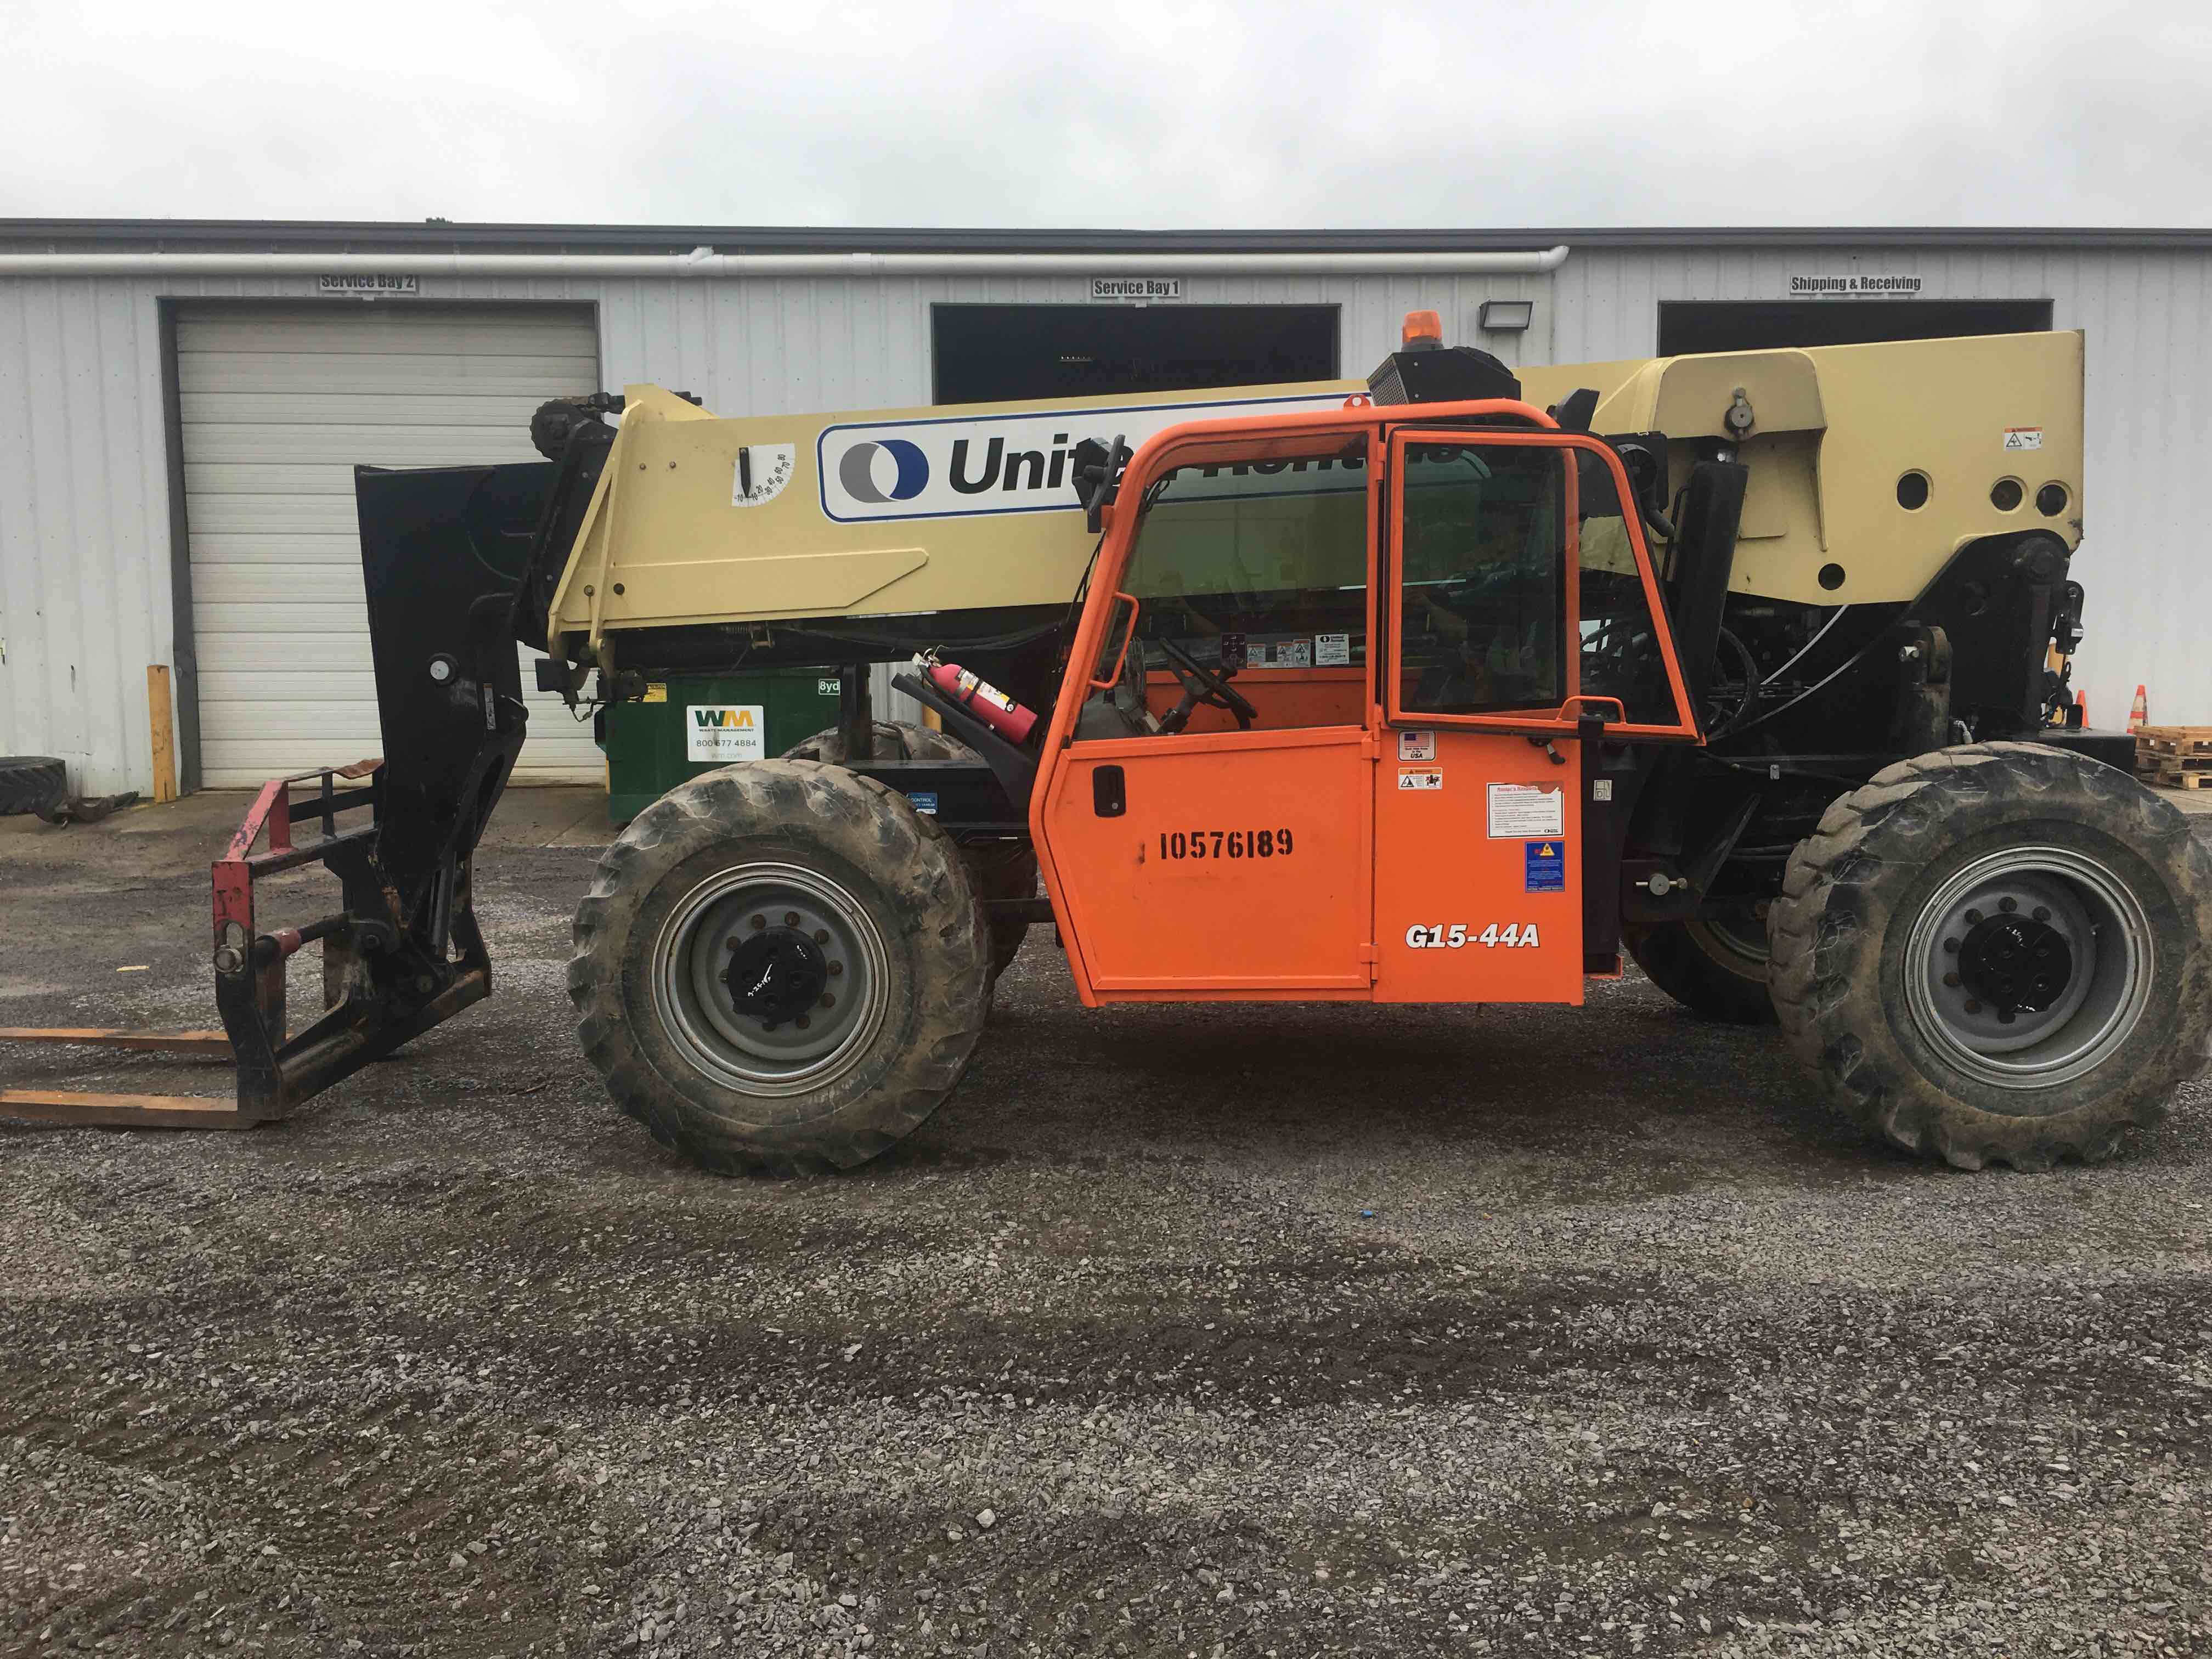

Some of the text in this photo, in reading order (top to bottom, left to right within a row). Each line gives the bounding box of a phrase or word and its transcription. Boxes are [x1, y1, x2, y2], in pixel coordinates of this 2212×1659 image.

[321, 274, 414, 290] Service Bay 2
[1094, 280, 1178, 296] Service Bay 1
[1791, 276, 1921, 291] Shipping & Receiving
[949, 432, 1134, 494] Unit
[820, 681, 839, 693] 8yd
[695, 710, 755, 727] WM
[1160, 828, 1293, 860] 10576189
[1405, 922, 1541, 949] G15-44A
